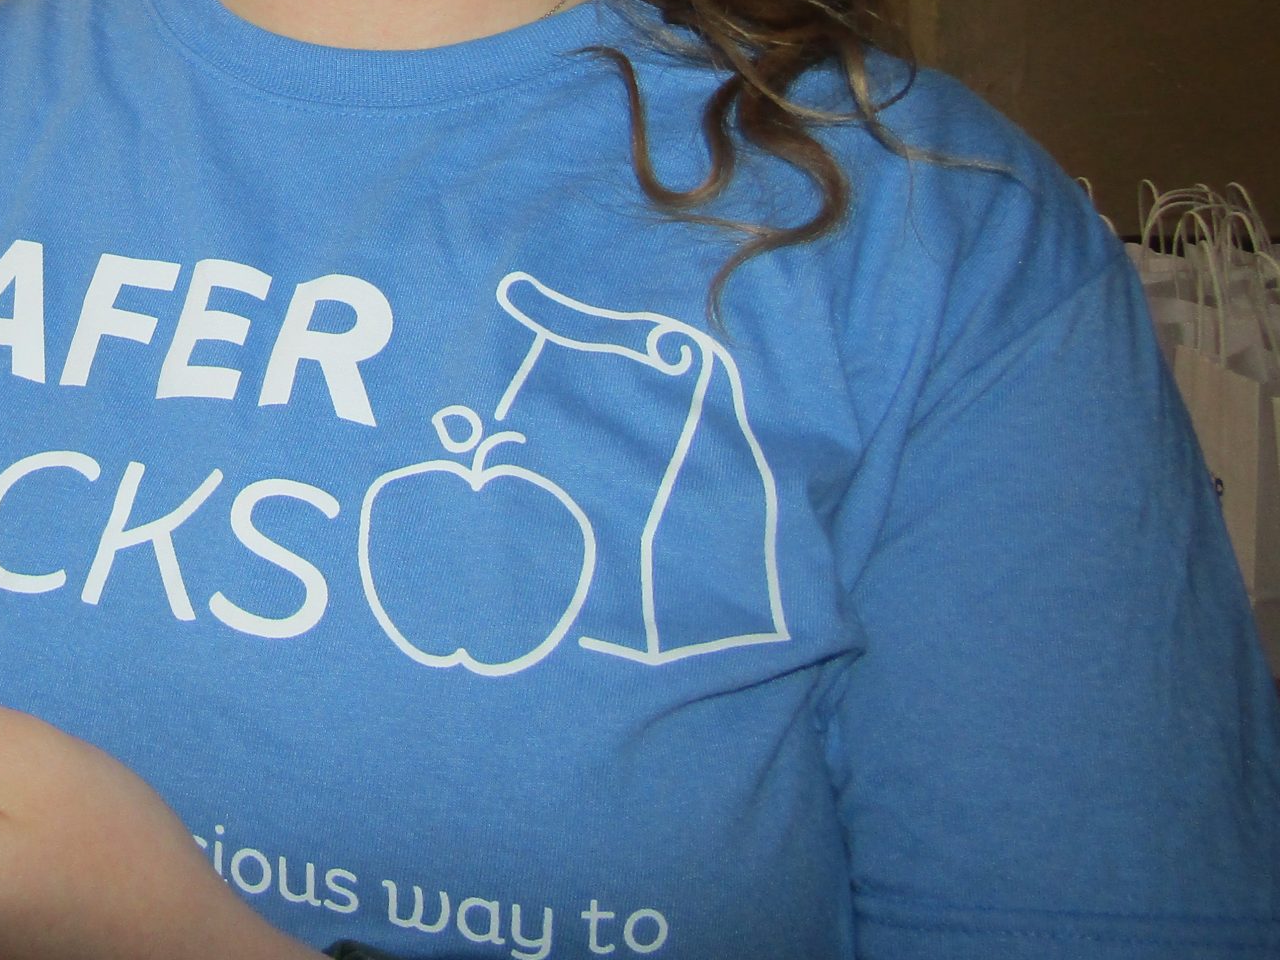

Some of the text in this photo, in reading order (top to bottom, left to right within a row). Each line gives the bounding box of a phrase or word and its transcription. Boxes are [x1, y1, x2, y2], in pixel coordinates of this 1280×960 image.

[192, 824, 669, 960] ious way to
